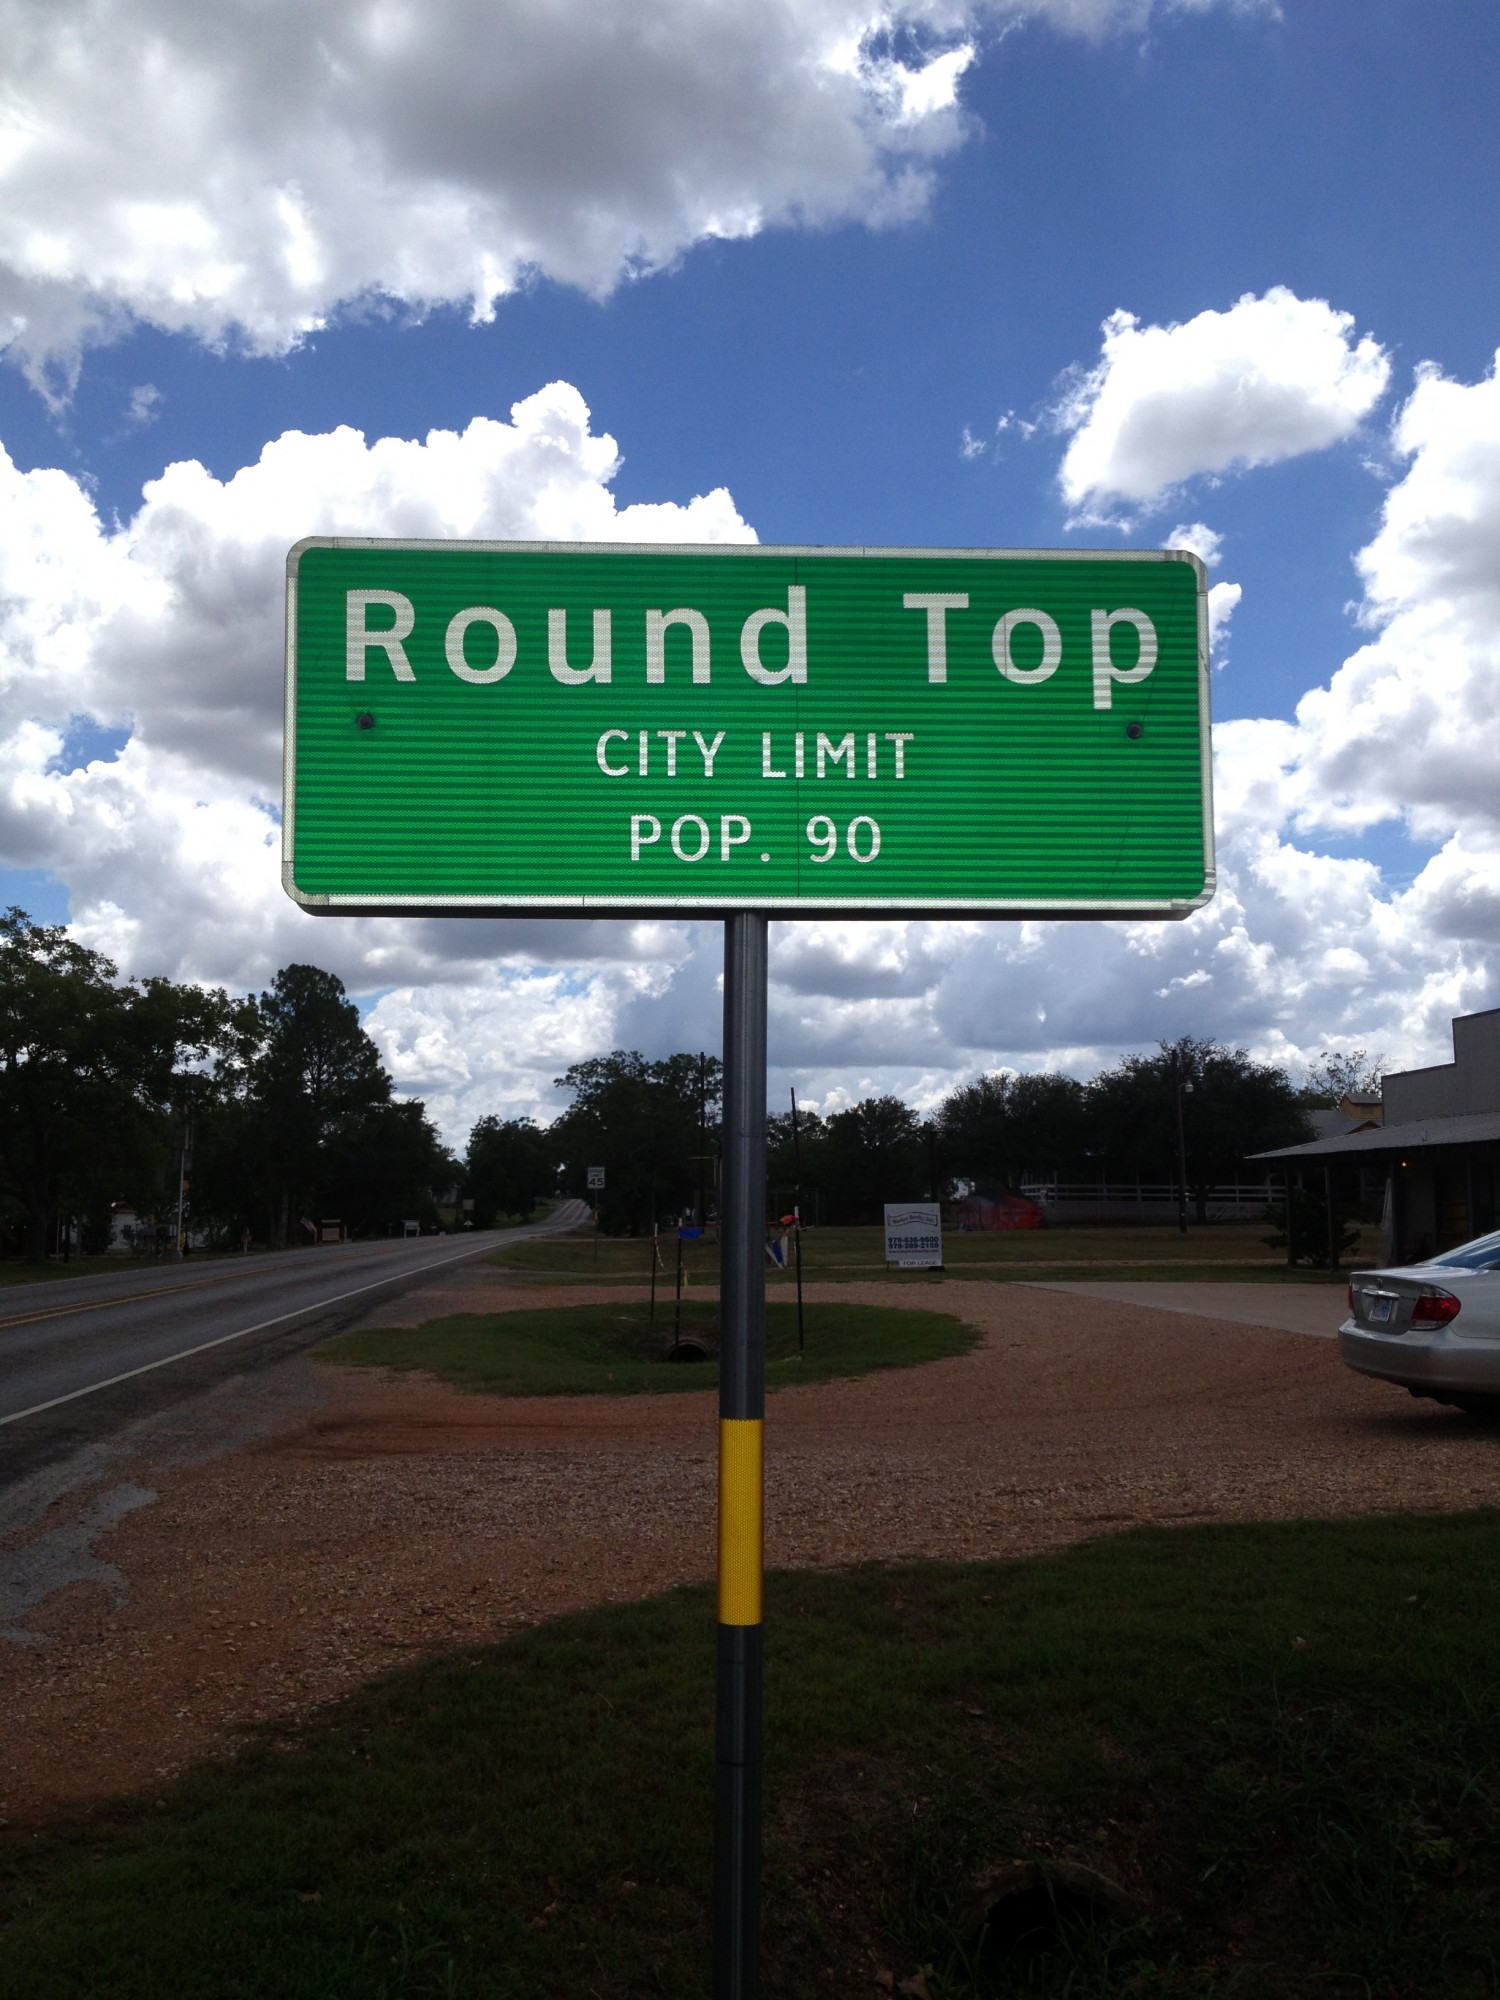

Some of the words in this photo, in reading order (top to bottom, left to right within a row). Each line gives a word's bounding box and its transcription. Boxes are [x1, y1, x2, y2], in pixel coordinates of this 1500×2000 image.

[345, 586, 808, 686] Round
[903, 592, 1158, 710] Top
[596, 729, 726, 777] CITY
[762, 732, 914, 779] LIMIT
[630, 814, 771, 862] POP.
[805, 815, 882, 863] 90
[589, 1178, 604, 1186] 45
